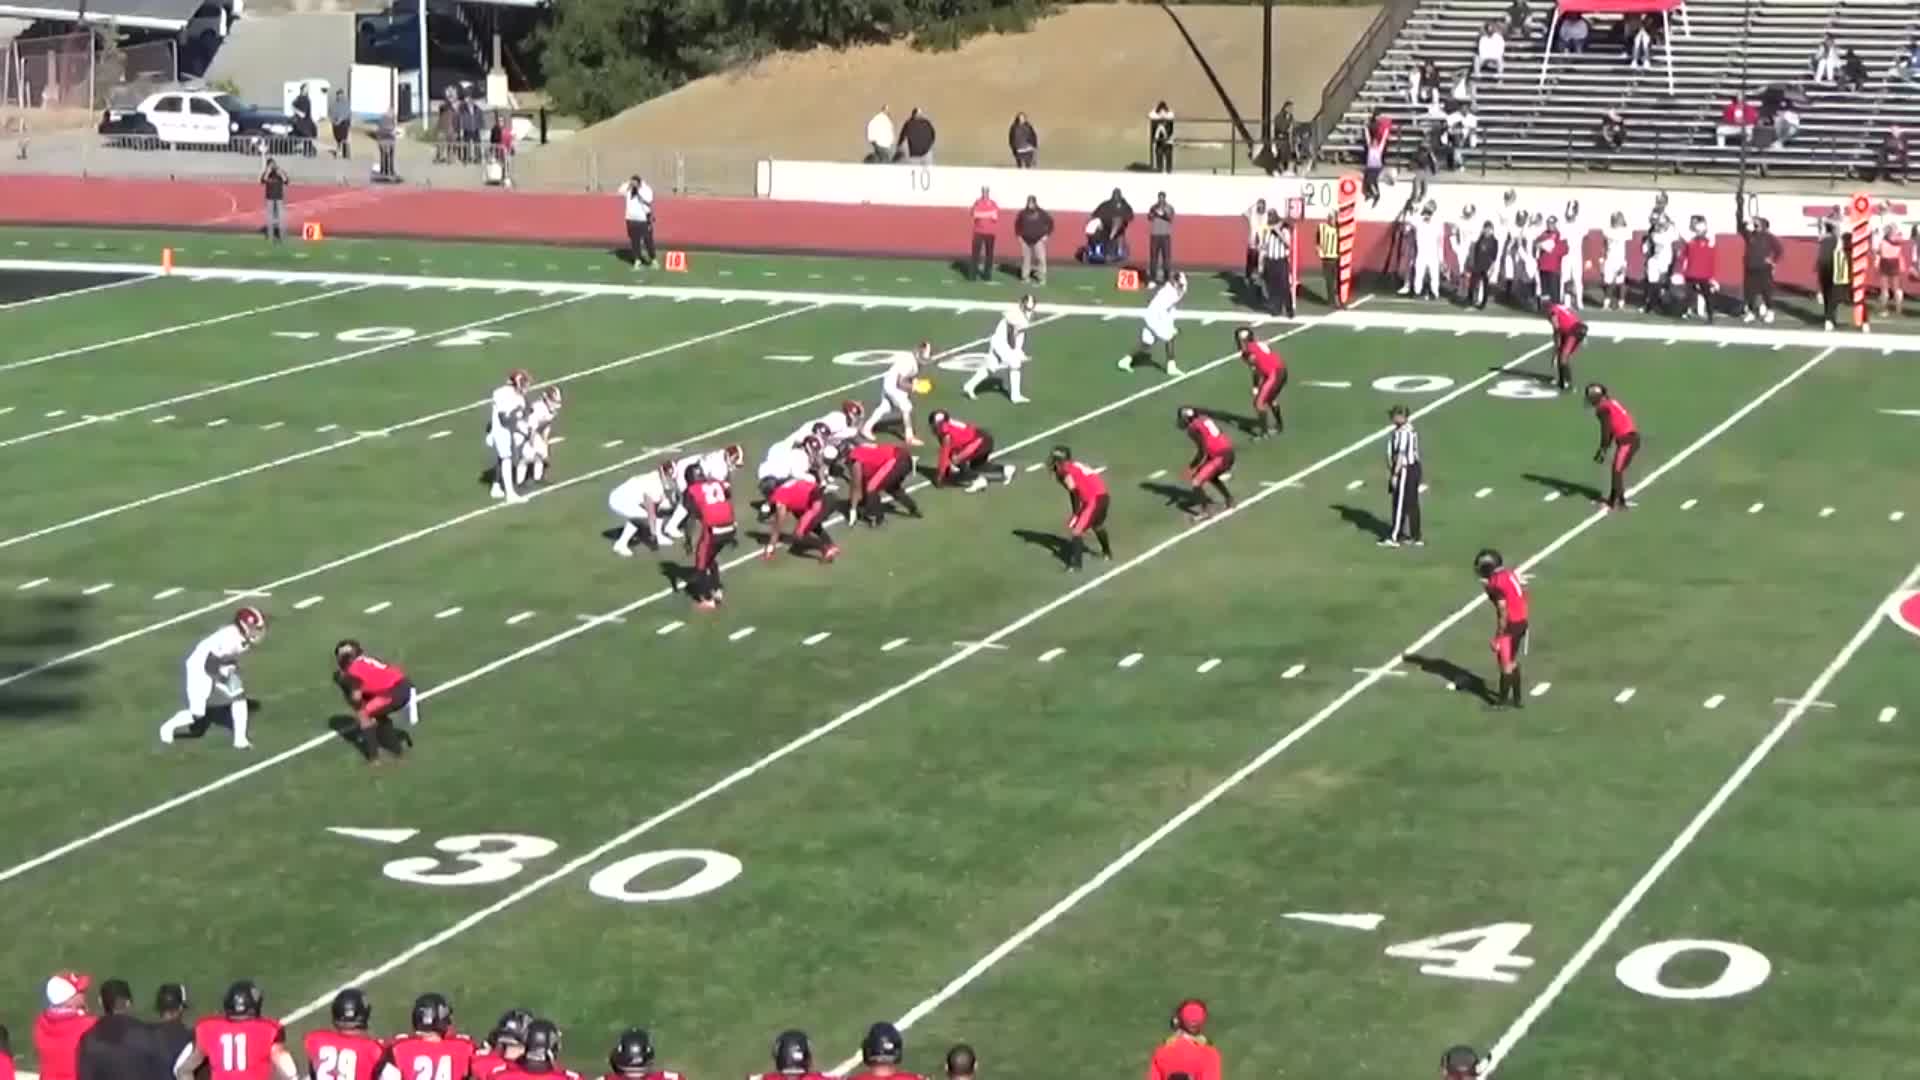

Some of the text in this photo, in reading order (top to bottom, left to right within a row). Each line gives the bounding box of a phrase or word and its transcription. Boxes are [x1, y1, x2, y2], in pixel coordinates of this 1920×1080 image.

[911, 168, 931, 191] 10
[219, 1032, 248, 1072] 11
[318, 1045, 357, 1080] 29
